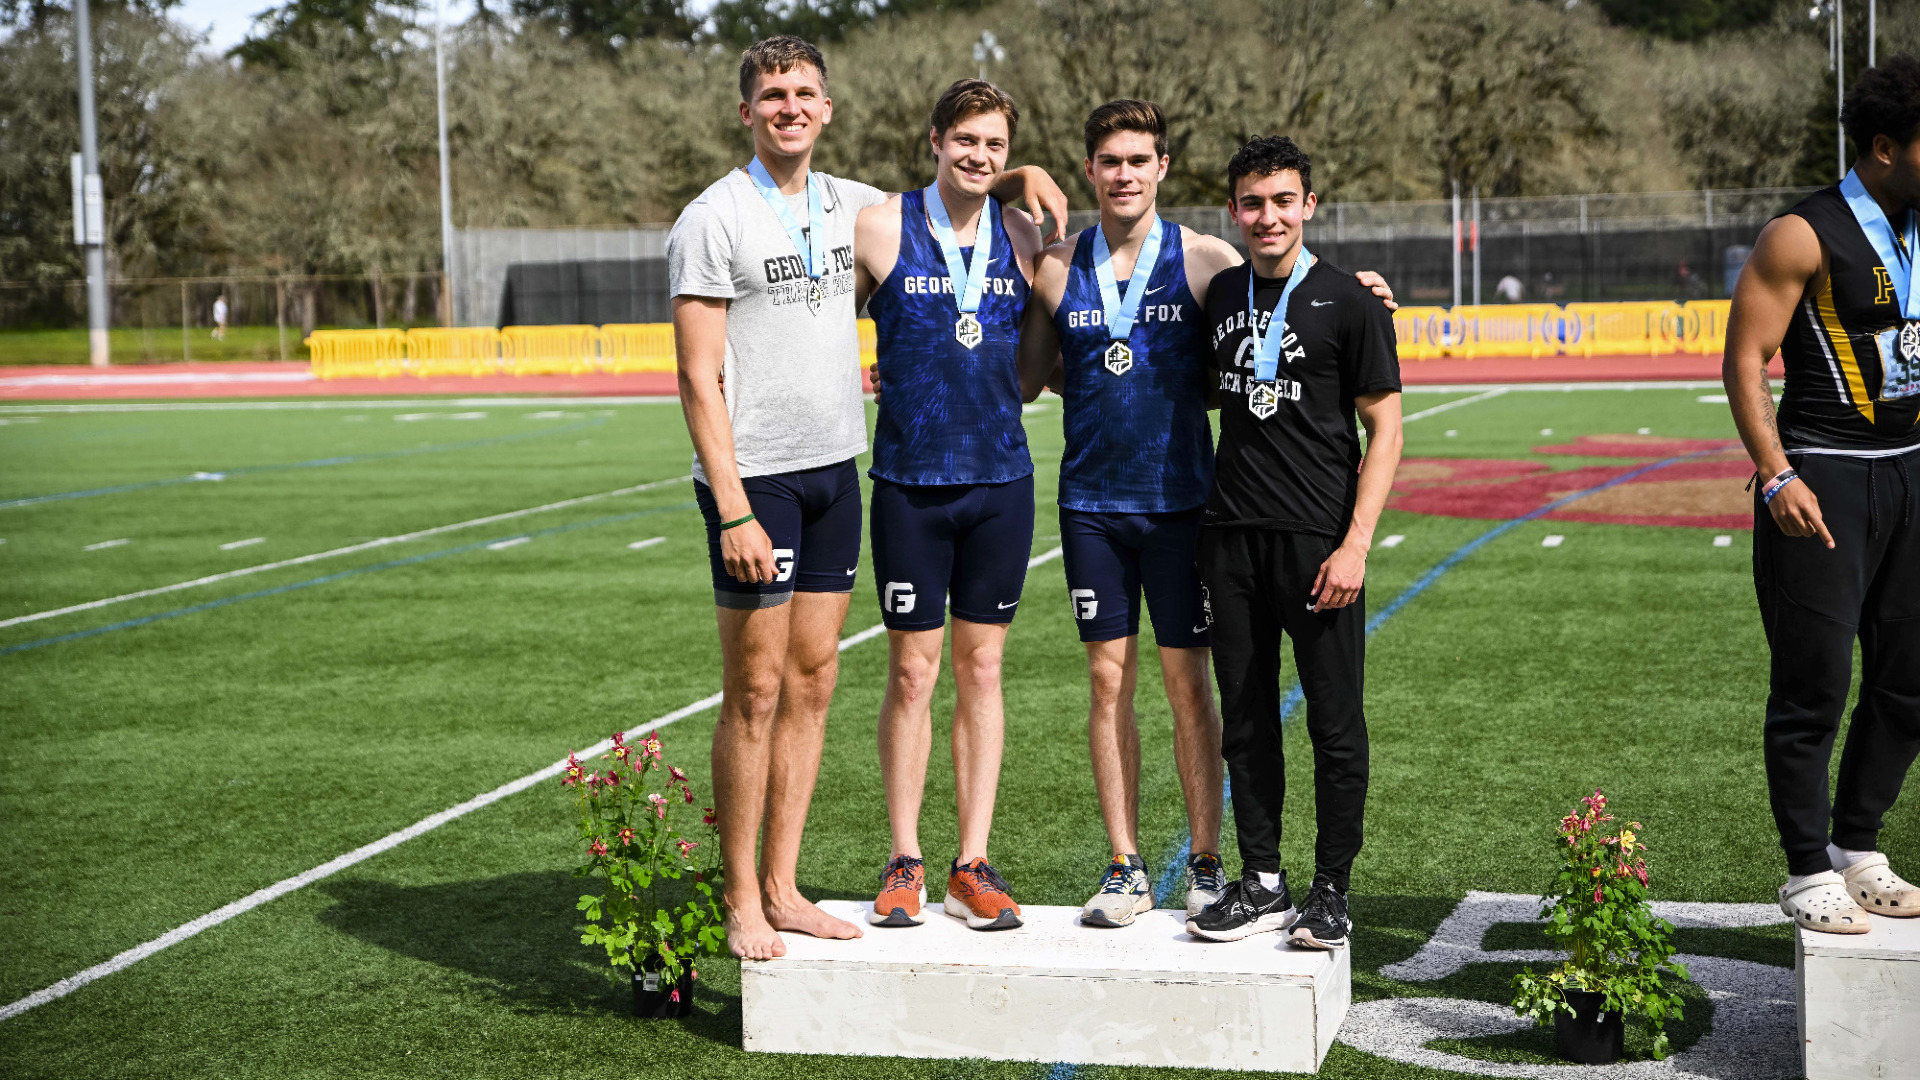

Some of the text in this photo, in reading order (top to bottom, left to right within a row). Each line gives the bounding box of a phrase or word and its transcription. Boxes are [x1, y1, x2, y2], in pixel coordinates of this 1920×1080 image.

[904, 276, 1016, 296] GEOR FOX
[1873, 266, 1895, 304] P
[1145, 304, 1183, 322] FOX
[1274, 378, 1302, 401] ELD
